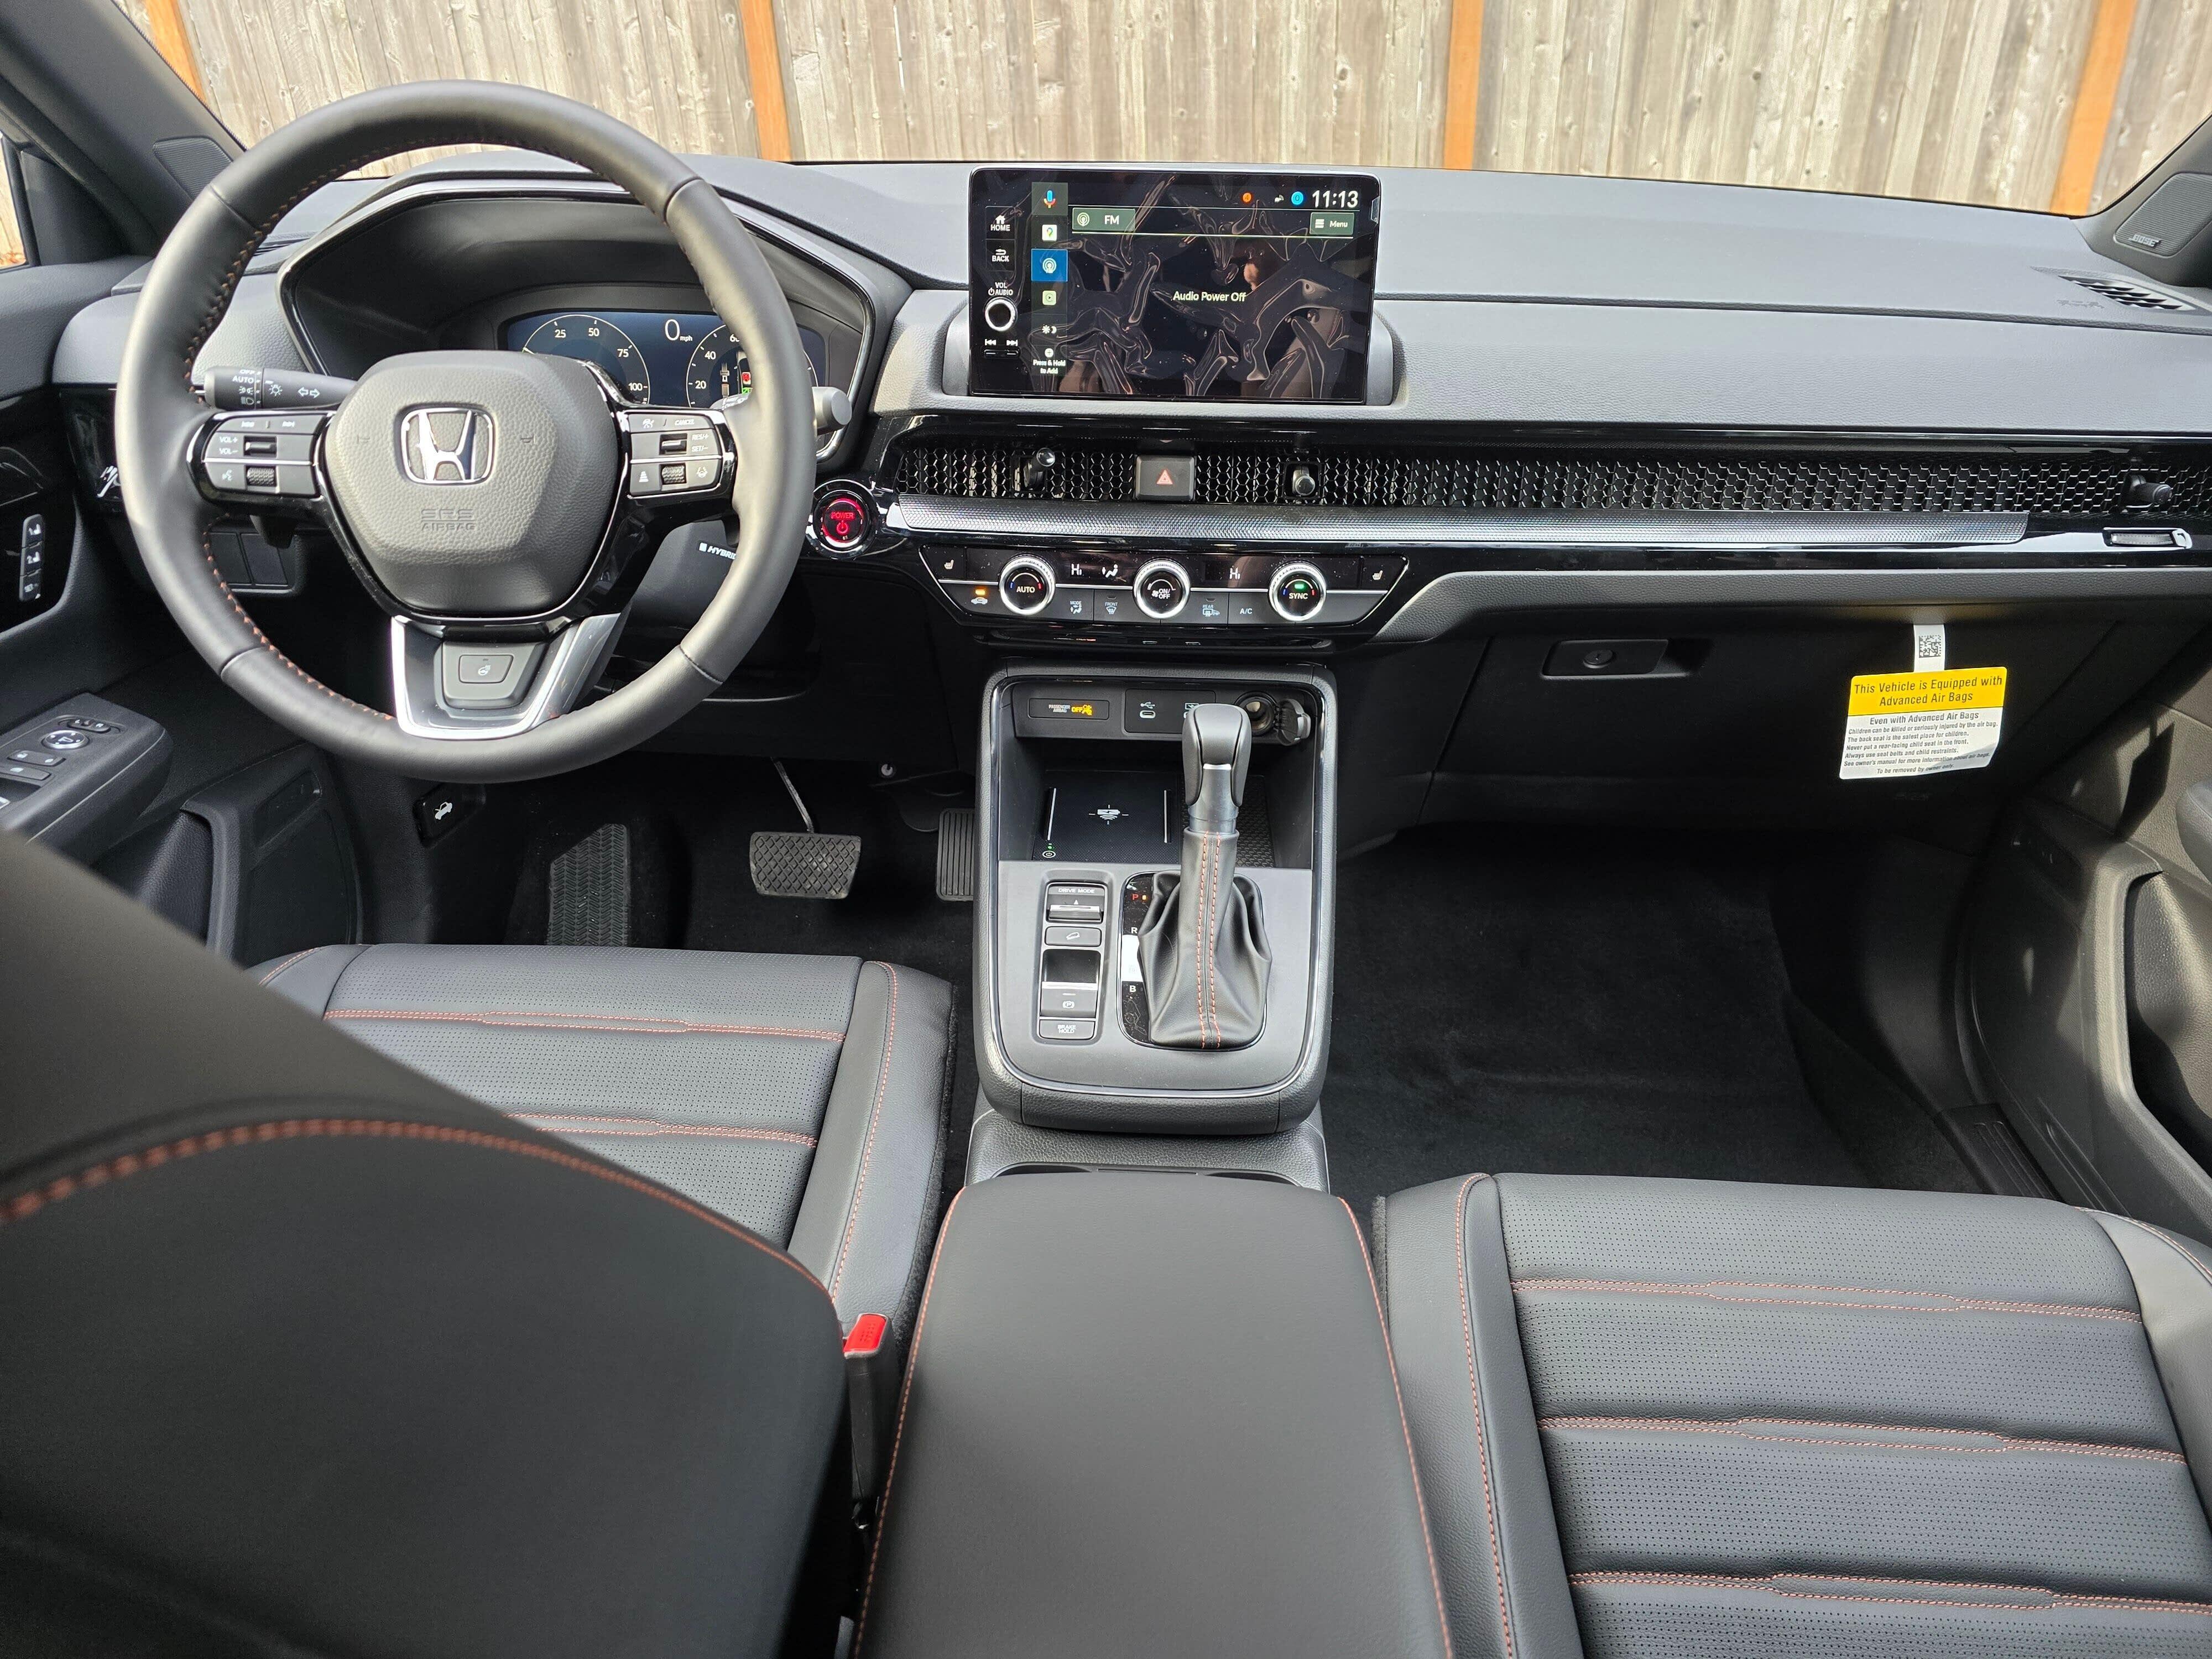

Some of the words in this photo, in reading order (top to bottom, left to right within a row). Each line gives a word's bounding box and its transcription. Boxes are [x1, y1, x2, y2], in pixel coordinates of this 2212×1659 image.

[1312, 190, 1358, 208] 11:13
[1104, 215, 1119, 225] FM
[1172, 291, 1199, 301] Audio
[1201, 291, 1229, 301] Power
[1231, 292, 1246, 302] Off
[555, 329, 566, 338] 25
[588, 328, 599, 337] 50
[665, 319, 680, 341] 0
[617, 349, 629, 358] 75
[705, 351, 716, 359] 40
[232, 375, 254, 384] AUTO
[628, 383, 643, 391] 100
[695, 380, 706, 389] 20
[421, 509, 473, 520] SRS
[421, 523, 476, 531] AIRBAG
[1855, 684, 1875, 694] This
[1879, 681, 1915, 692] Vehicle
[1919, 680, 1927, 690] is
[1931, 677, 1977, 690] Equipped
[1981, 676, 2002, 686] with
[1880, 694, 1928, 706] Advanced
[1931, 693, 1945, 702] Air
[1949, 692, 1973, 703] Bags
[1908, 713, 1944, 723] Advanced
[1960, 712, 1979, 720] Bags
